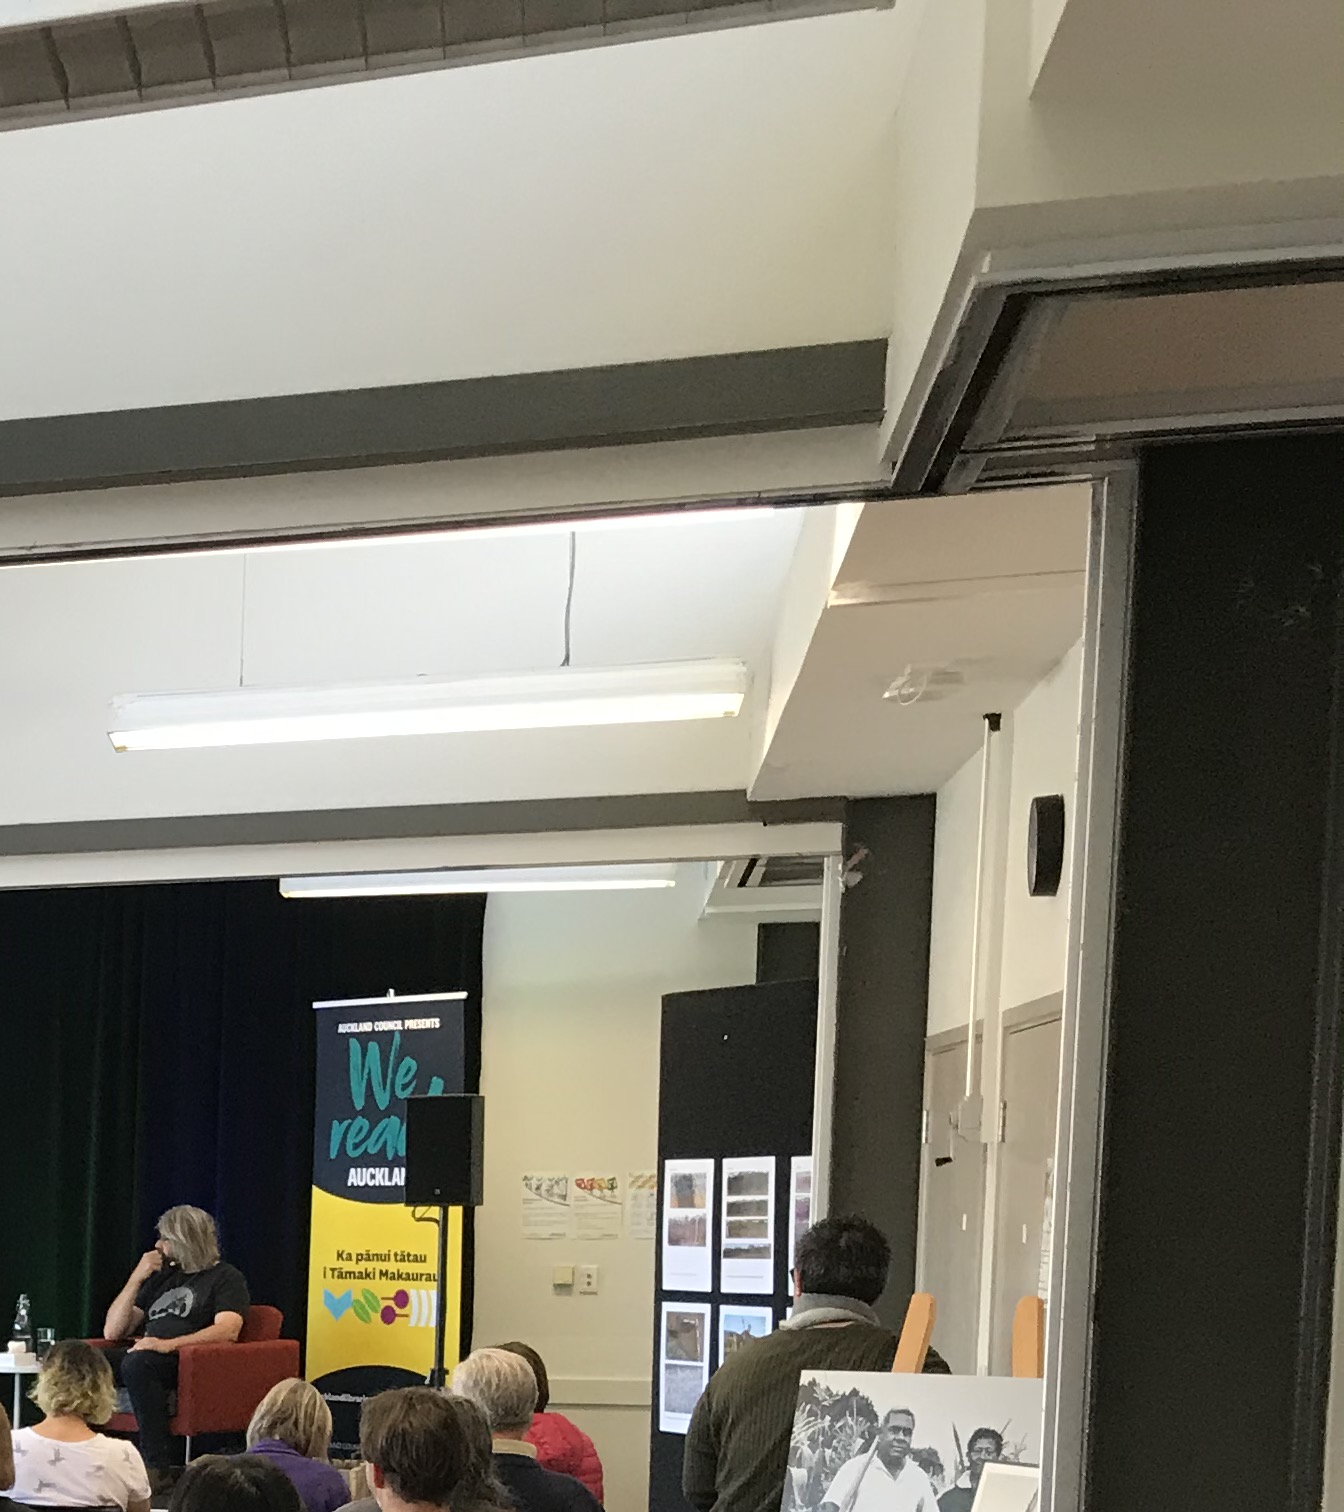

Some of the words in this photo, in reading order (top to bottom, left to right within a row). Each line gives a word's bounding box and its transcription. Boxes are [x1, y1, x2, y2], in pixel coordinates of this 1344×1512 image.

[337, 1022, 372, 1033] AUCKLAND
[374, 1020, 403, 1031] COUNCIL
[404, 1018, 440, 1030] PRESENTS
[349, 1031, 418, 1111] We
[347, 1167, 406, 1187] AUCKLA
[336, 1249, 353, 1261] Ka
[355, 1249, 391, 1265] pānui
[394, 1250, 427, 1263] tātau
[323, 1266, 327, 1279] i
[329, 1267, 376, 1280] Tāmaki
